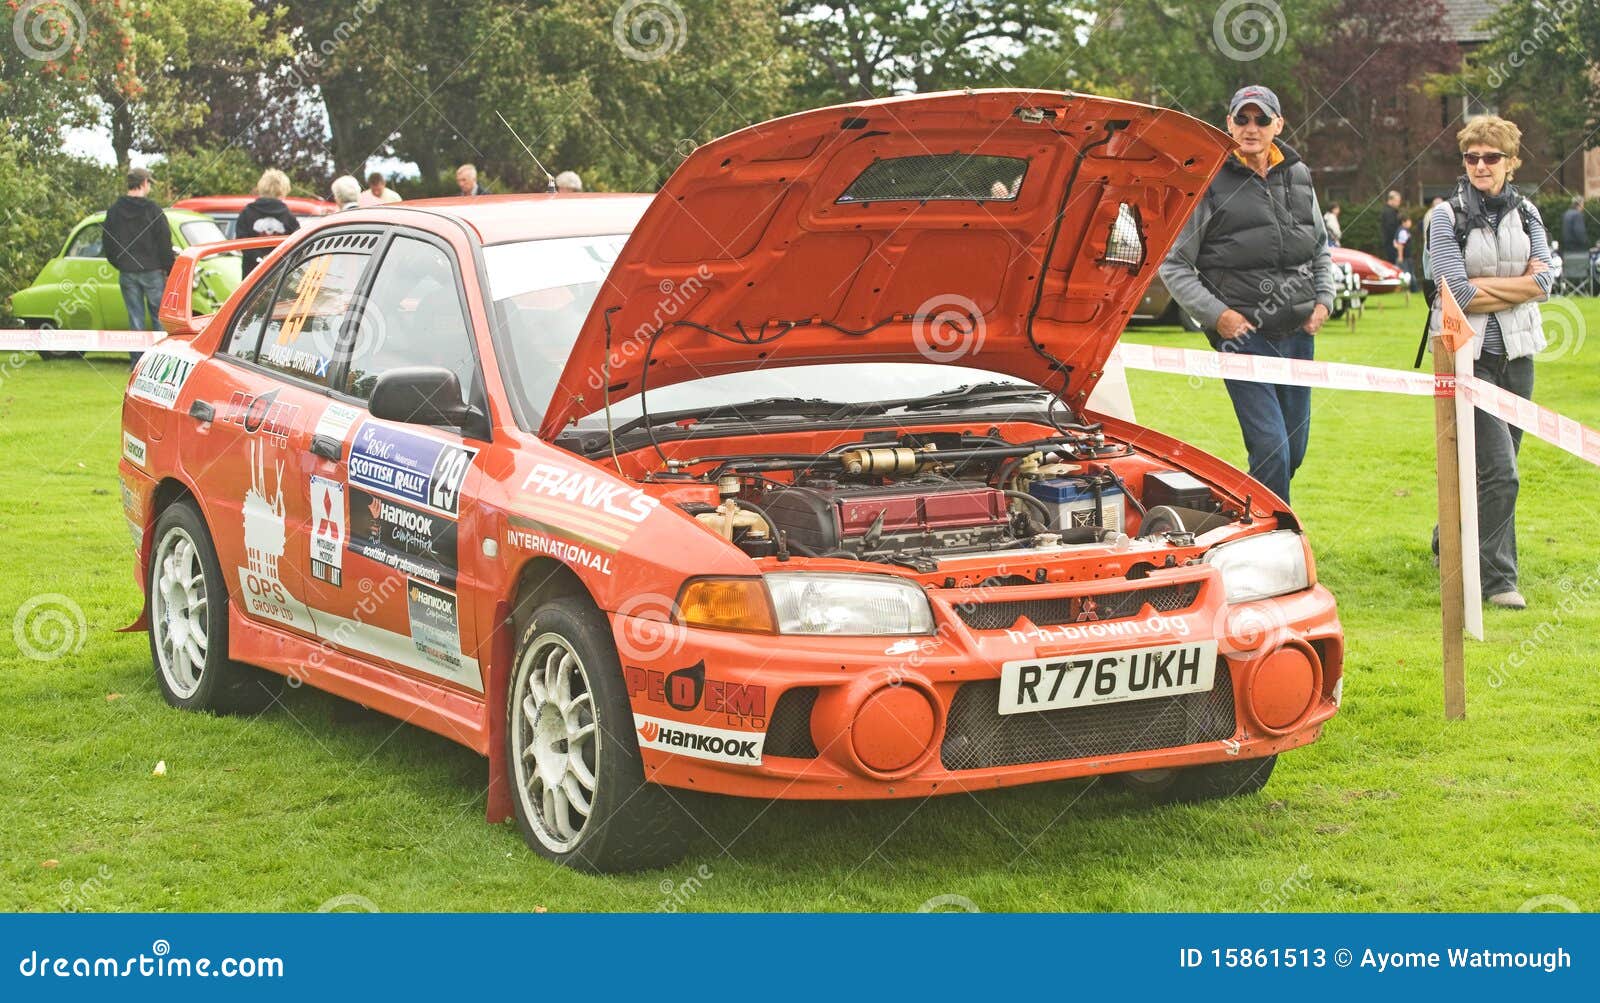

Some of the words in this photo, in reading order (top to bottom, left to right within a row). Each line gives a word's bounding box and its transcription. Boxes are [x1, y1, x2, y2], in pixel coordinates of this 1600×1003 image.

[271, 436, 287, 449] LTD
[365, 441, 395, 460] RSAC
[432, 449, 468, 510] 29
[521, 463, 661, 523] FRANK'S
[506, 529, 612, 575] INTERNATIONAL
[247, 574, 286, 604] OPS
[252, 598, 279, 616] GROUP
[281, 608, 294, 621] LTD
[1016, 657, 1118, 706] R776
[1127, 646, 1201, 692] UKH
[727, 716, 766, 729] LTD
